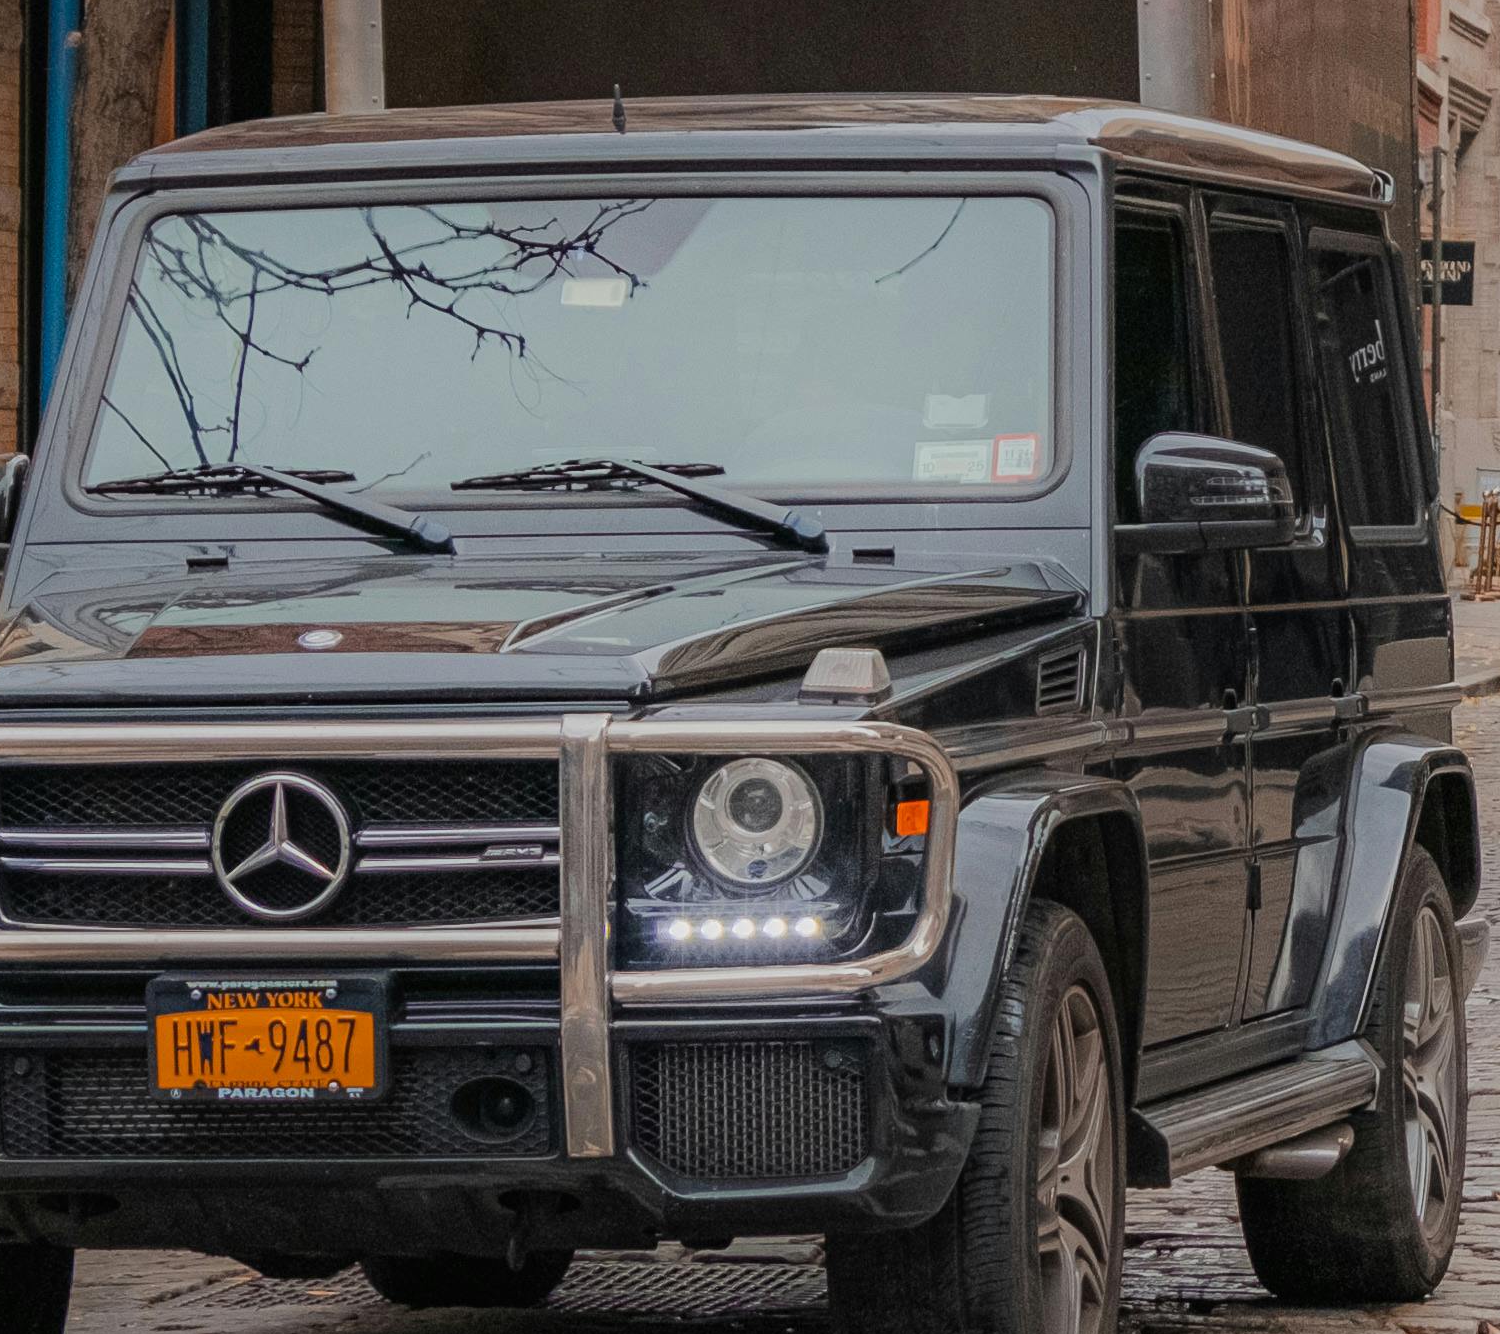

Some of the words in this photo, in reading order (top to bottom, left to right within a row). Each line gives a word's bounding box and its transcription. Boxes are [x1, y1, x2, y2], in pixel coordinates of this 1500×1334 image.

[207, 992, 260, 1010] NEW
[263, 991, 324, 1008] YORK
[218, 1087, 315, 1099] PARAGON
